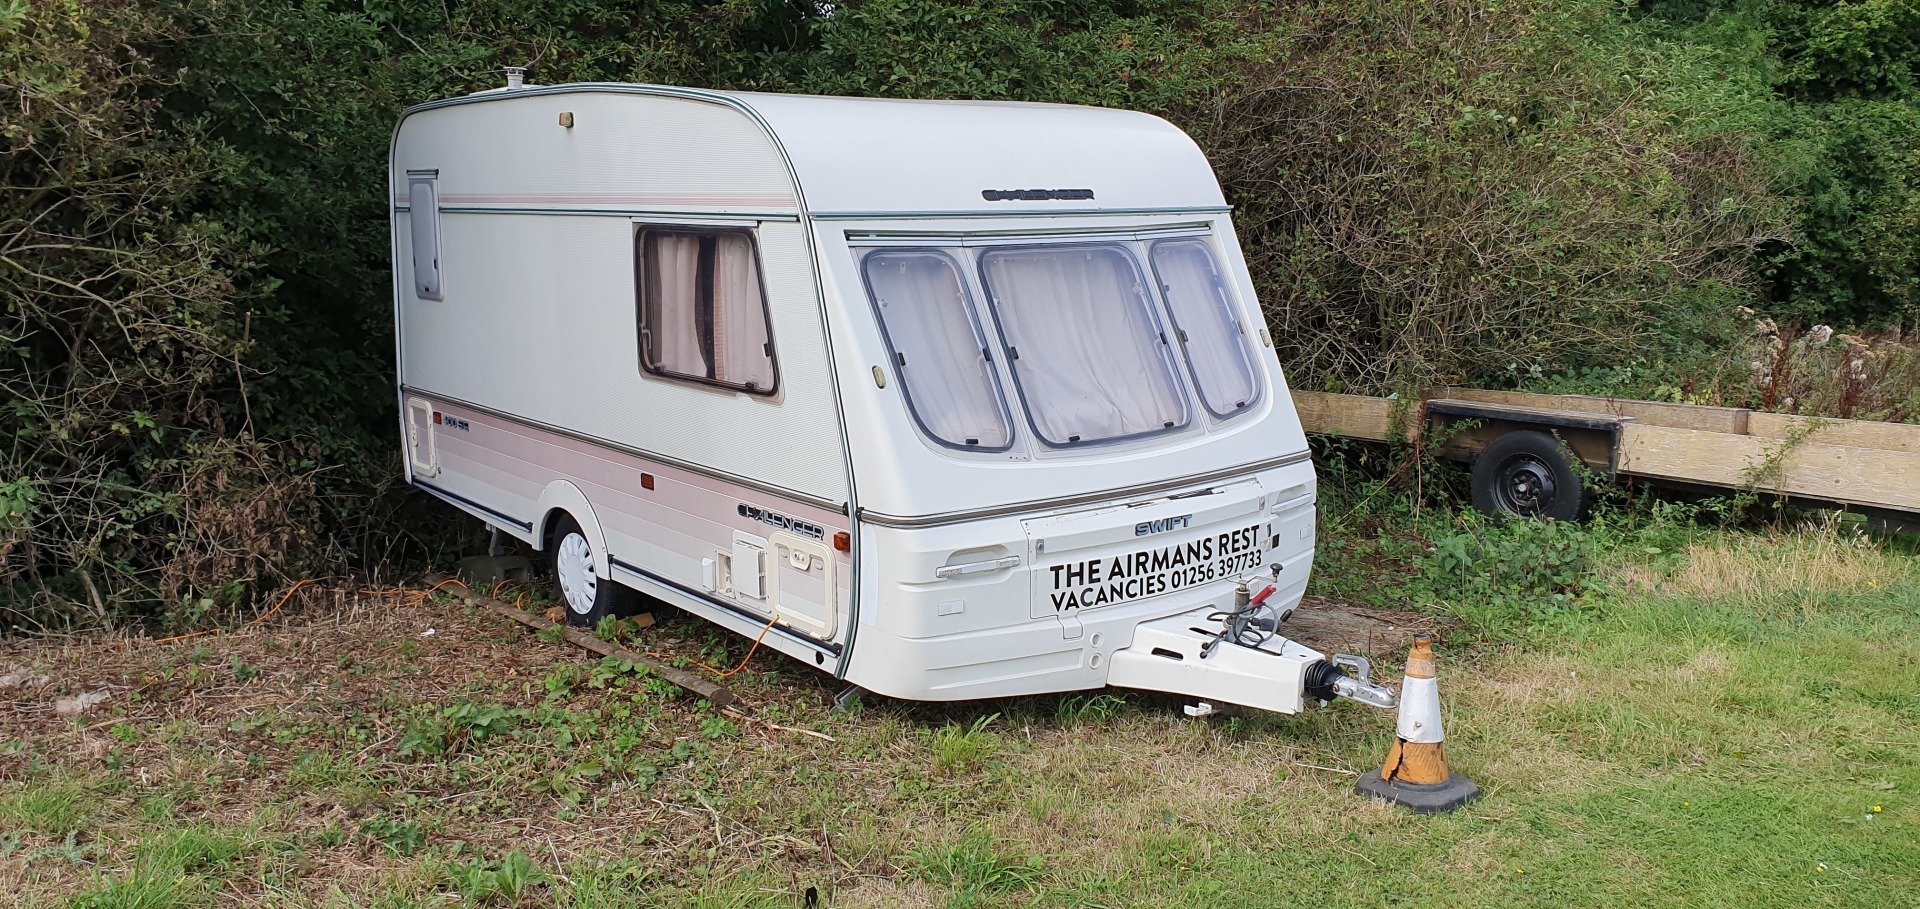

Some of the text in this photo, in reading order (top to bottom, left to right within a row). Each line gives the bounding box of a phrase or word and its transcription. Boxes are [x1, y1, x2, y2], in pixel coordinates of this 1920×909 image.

[1135, 514, 1192, 536] SWIFT
[1050, 525, 1260, 589] THE AIRMANS REST
[1051, 549, 1262, 612] VACANCIES 01256 397733
